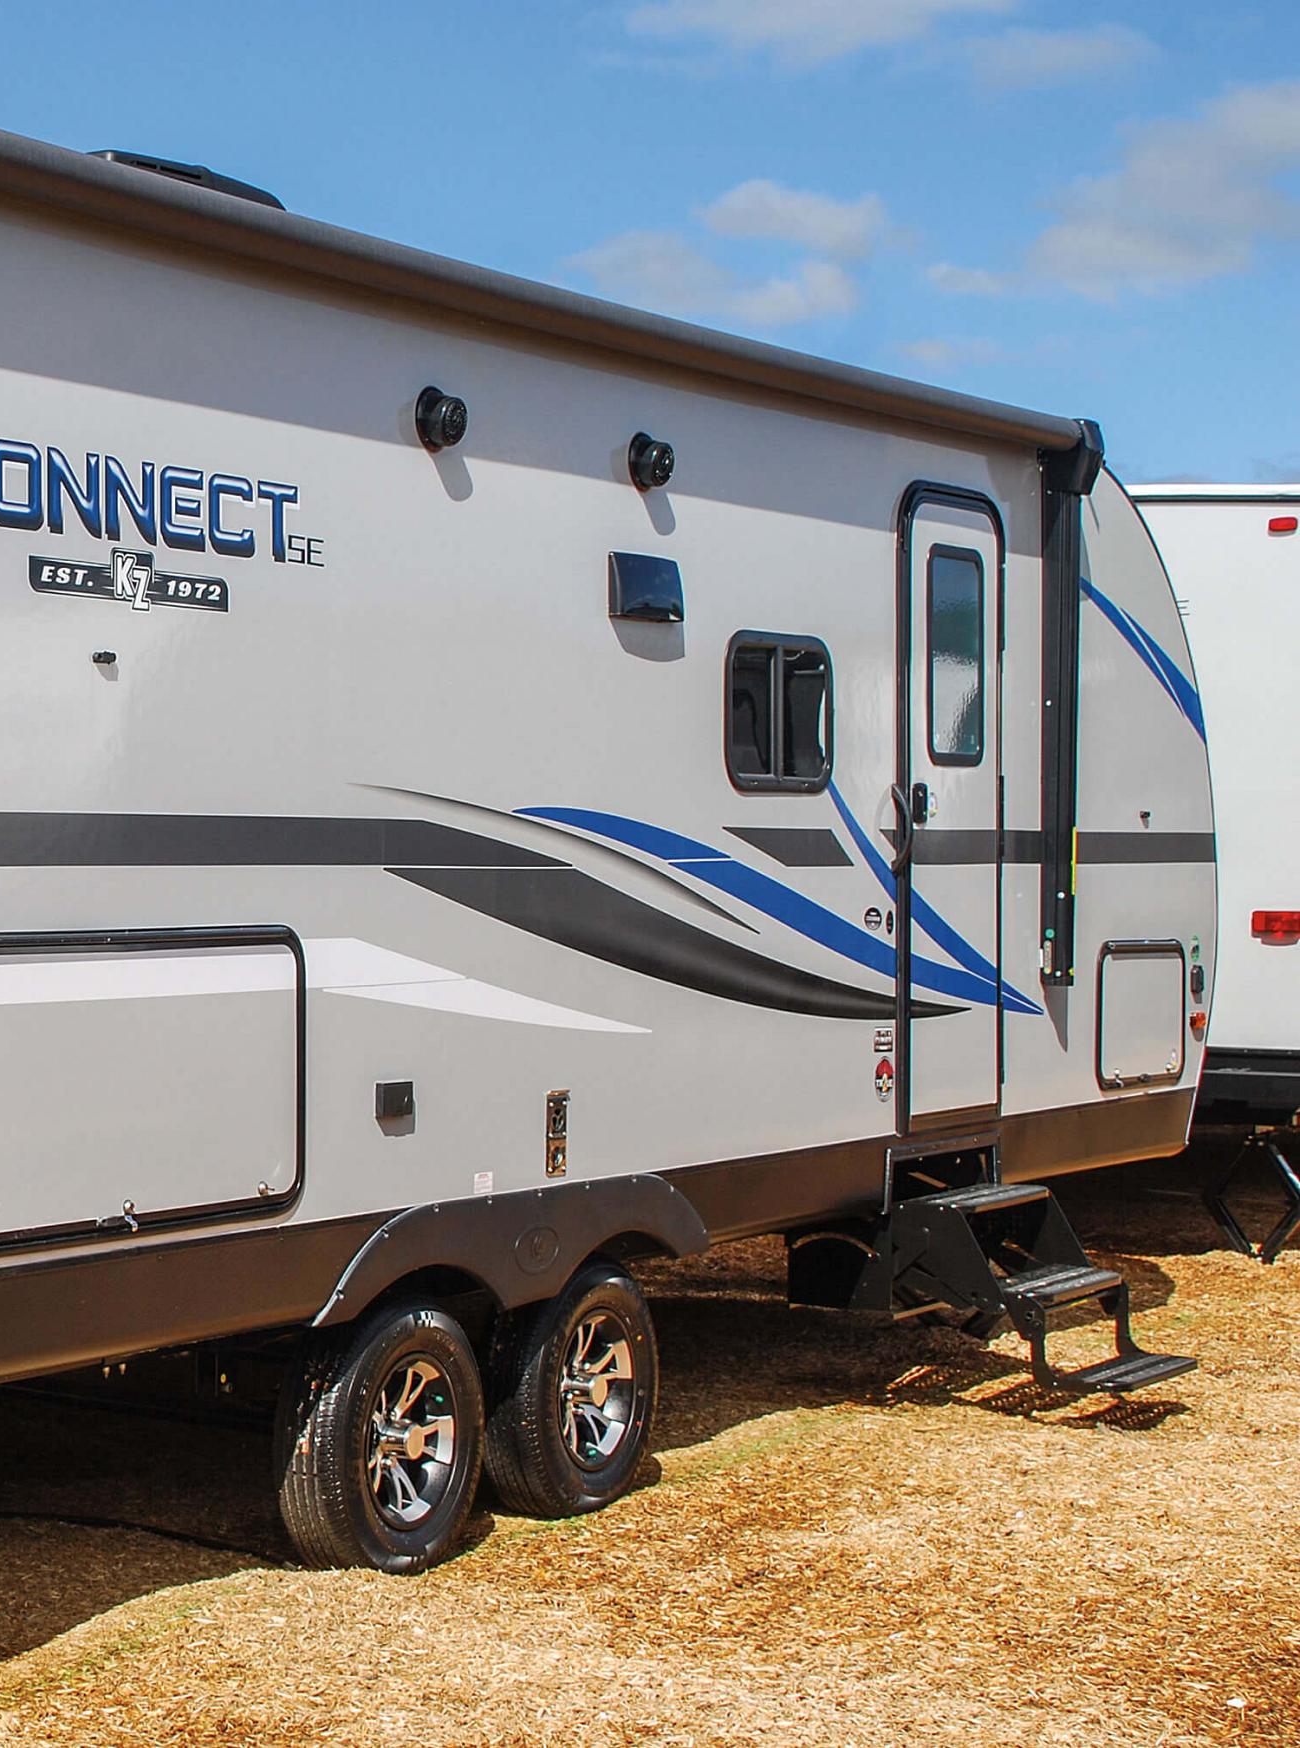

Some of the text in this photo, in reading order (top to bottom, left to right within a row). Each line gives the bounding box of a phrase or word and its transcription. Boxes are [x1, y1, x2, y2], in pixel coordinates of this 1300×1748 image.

[287, 534, 325, 568] SE
[40, 552, 222, 612] EST. KZ 1972
